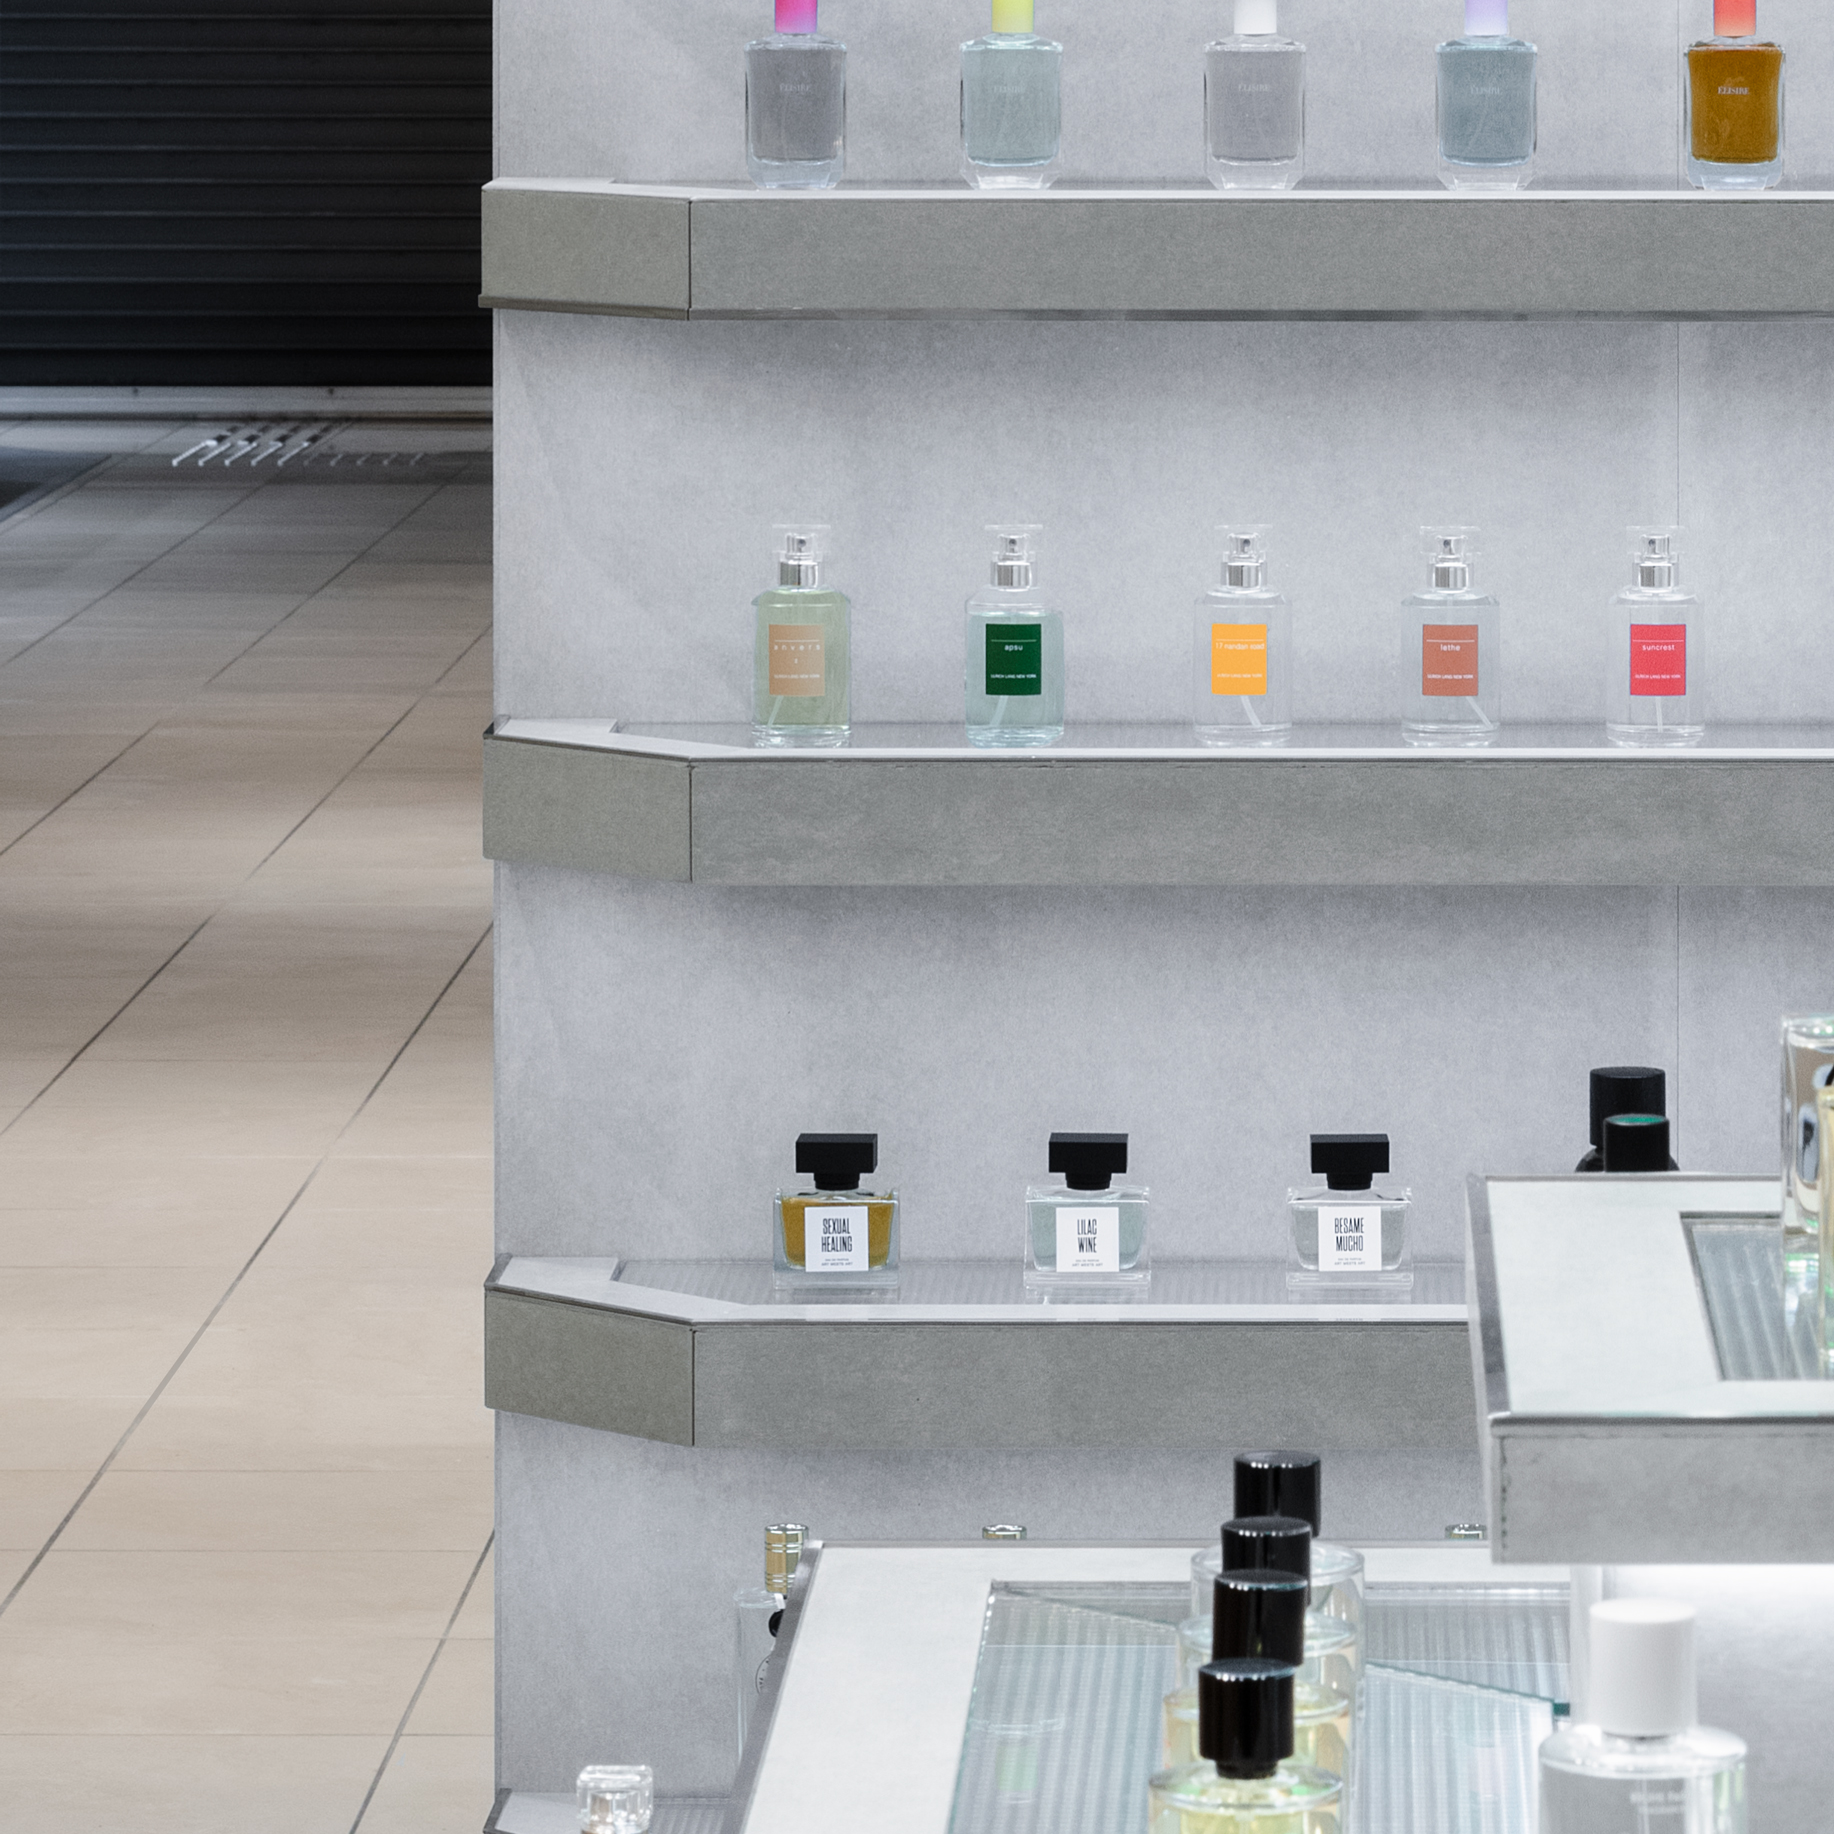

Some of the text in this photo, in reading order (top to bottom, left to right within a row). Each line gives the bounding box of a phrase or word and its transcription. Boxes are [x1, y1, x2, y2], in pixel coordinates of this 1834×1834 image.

[1004, 644, 1024, 652] apsu
[822, 1217, 851, 1235] SEXUAL
[1077, 1218, 1098, 1236] LILAC
[1334, 1217, 1365, 1235] BESAME
[821, 1235, 853, 1253] HEALING
[1077, 1236, 1098, 1254] WINE
[1336, 1235, 1364, 1252] MUCHO
